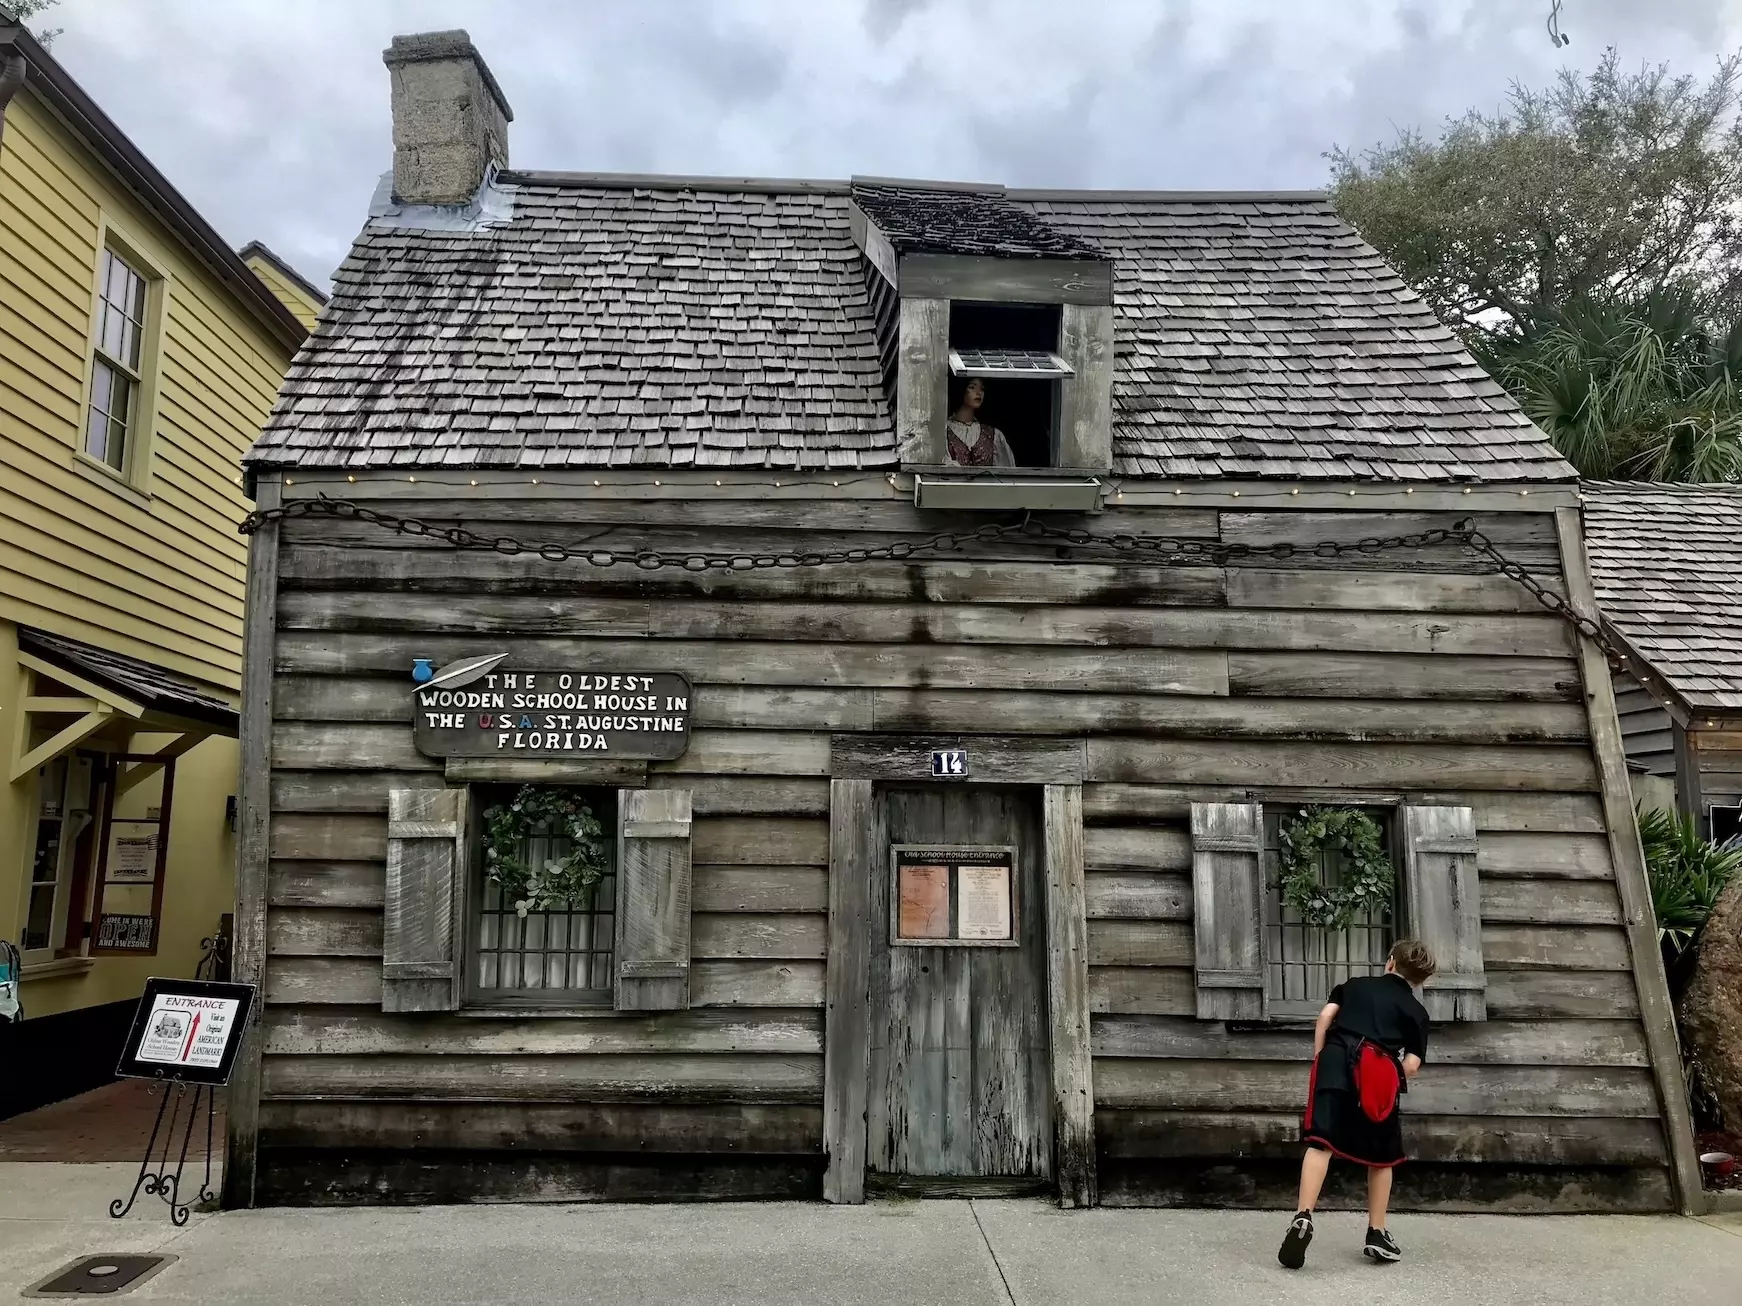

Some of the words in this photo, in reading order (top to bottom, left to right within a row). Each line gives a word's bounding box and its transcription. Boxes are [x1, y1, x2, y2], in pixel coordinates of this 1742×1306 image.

[485, 674, 536, 689] THE
[559, 675, 654, 692] OLDEST
[420, 691, 505, 708] WOODEN
[511, 693, 588, 710] SCHOOL
[594, 695, 657, 711] HOUSE
[666, 697, 688, 711] IN
[425, 713, 466, 729] THE
[497, 732, 609, 750] FLORIDA
[940, 752, 962, 773] 14
[99, 923, 152, 941] OPEN
[98, 939, 113, 947] AND
[114, 940, 150, 948] AWESOME
[166, 997, 226, 1009] ENTRANCE
[198, 1035, 224, 1044] AMERICAN
